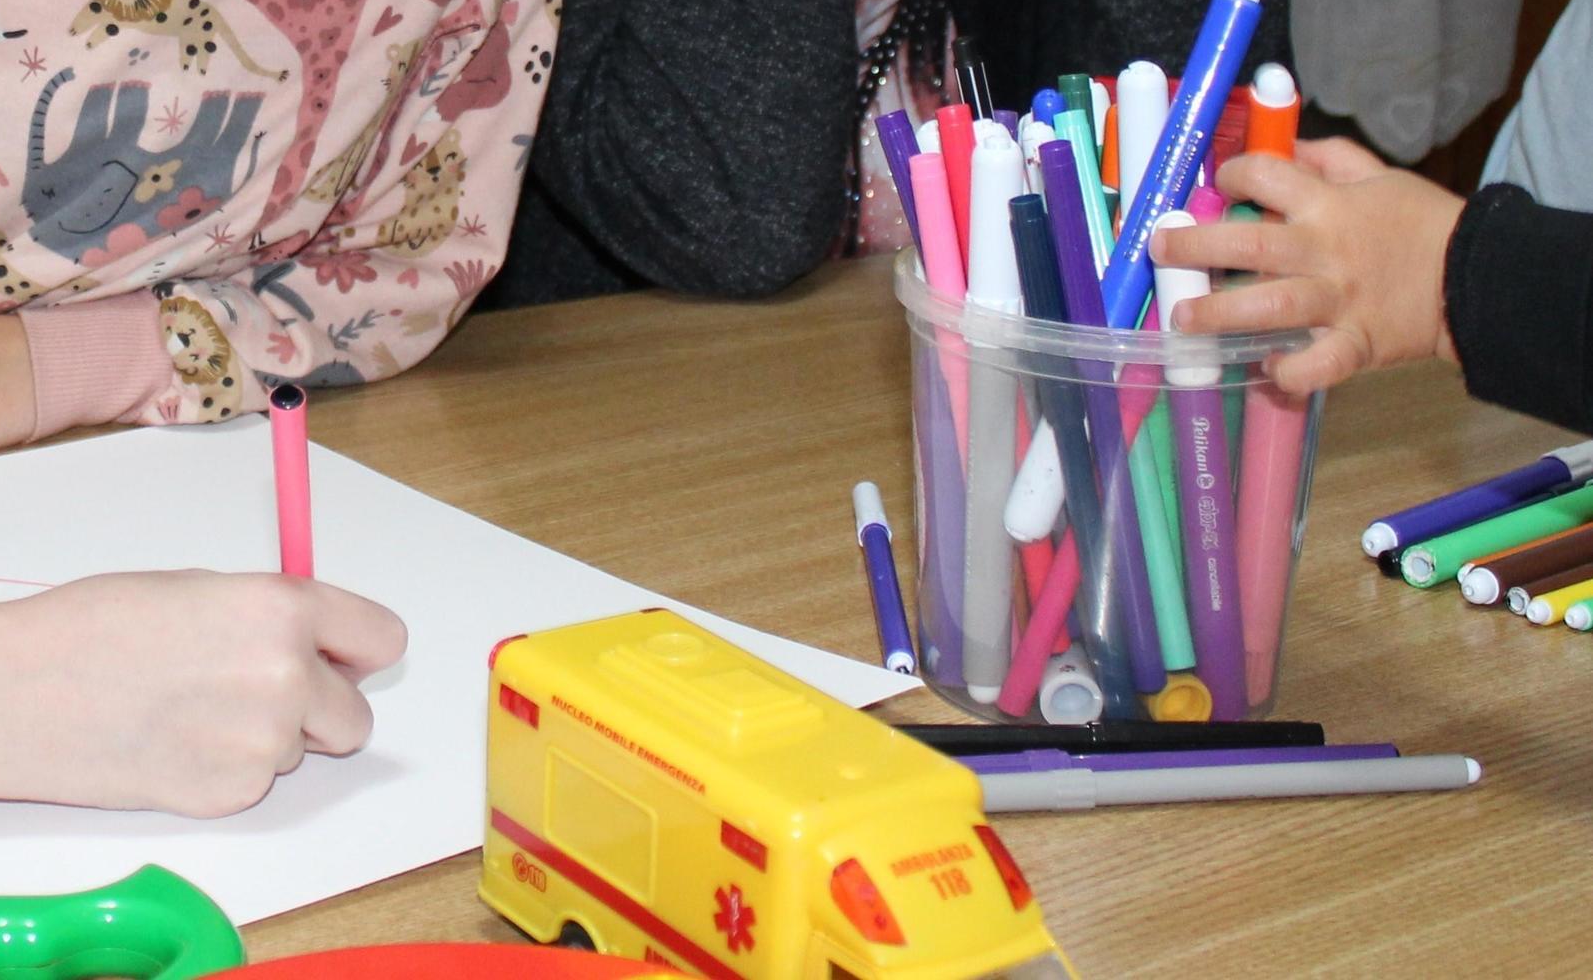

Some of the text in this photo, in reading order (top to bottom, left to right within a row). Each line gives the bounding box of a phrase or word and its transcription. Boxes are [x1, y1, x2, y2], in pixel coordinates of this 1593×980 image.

[1191, 417, 1210, 473] Pelikan
[551, 695, 706, 795] NUCLEO MOBILE EMERGENZA
[929, 868, 972, 901] 118
